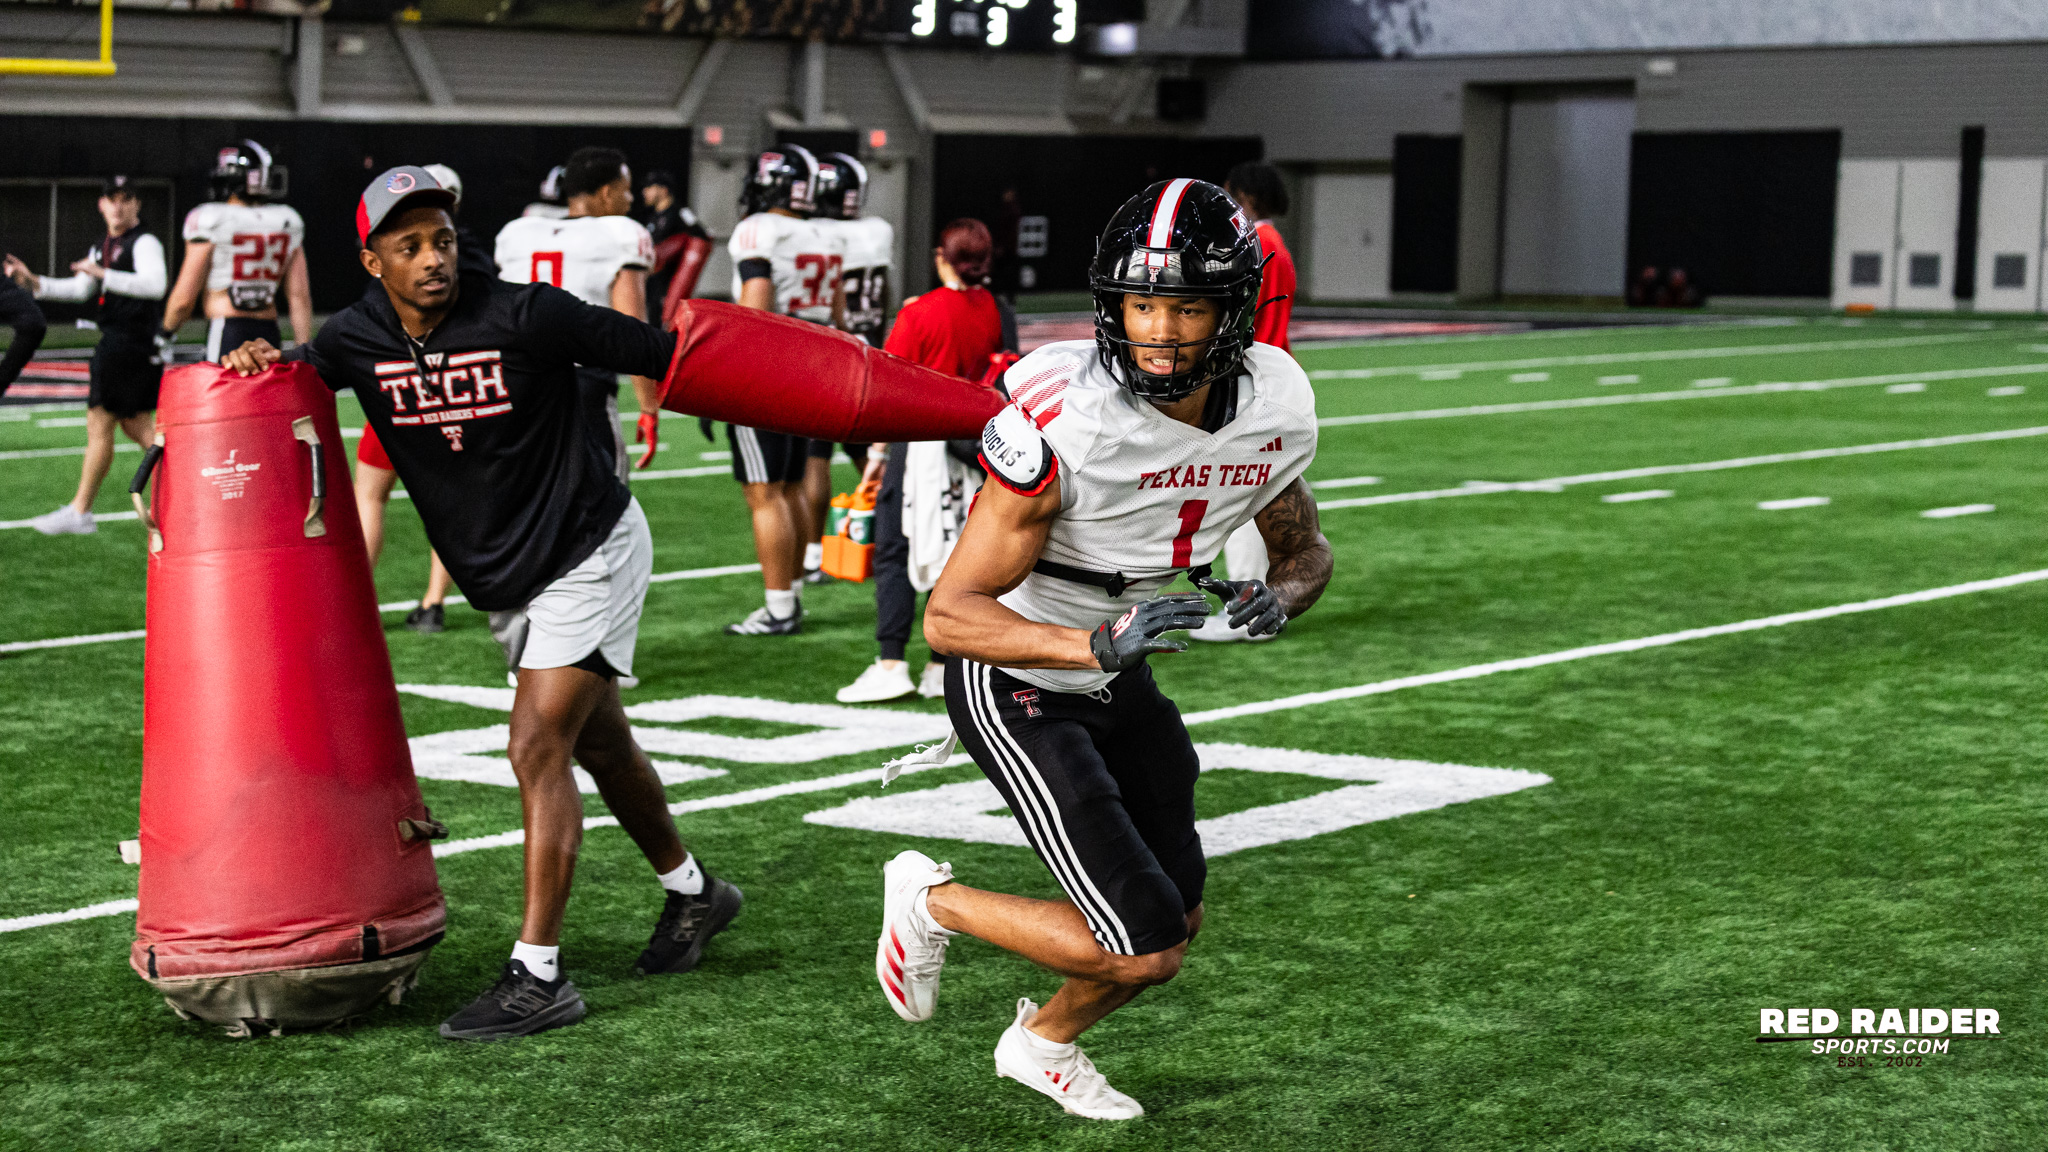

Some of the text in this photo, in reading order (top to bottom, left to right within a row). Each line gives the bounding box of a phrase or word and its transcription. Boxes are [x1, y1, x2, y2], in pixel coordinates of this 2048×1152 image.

[232, 232, 291, 281] 23
[379, 363, 509, 412] TECH
[422, 409, 474, 424] RED RAIDERS
[983, 418, 1021, 467] DOUGLAS
[1137, 463, 1272, 490] TEXAS TECH
[1171, 499, 1209, 568] 1
